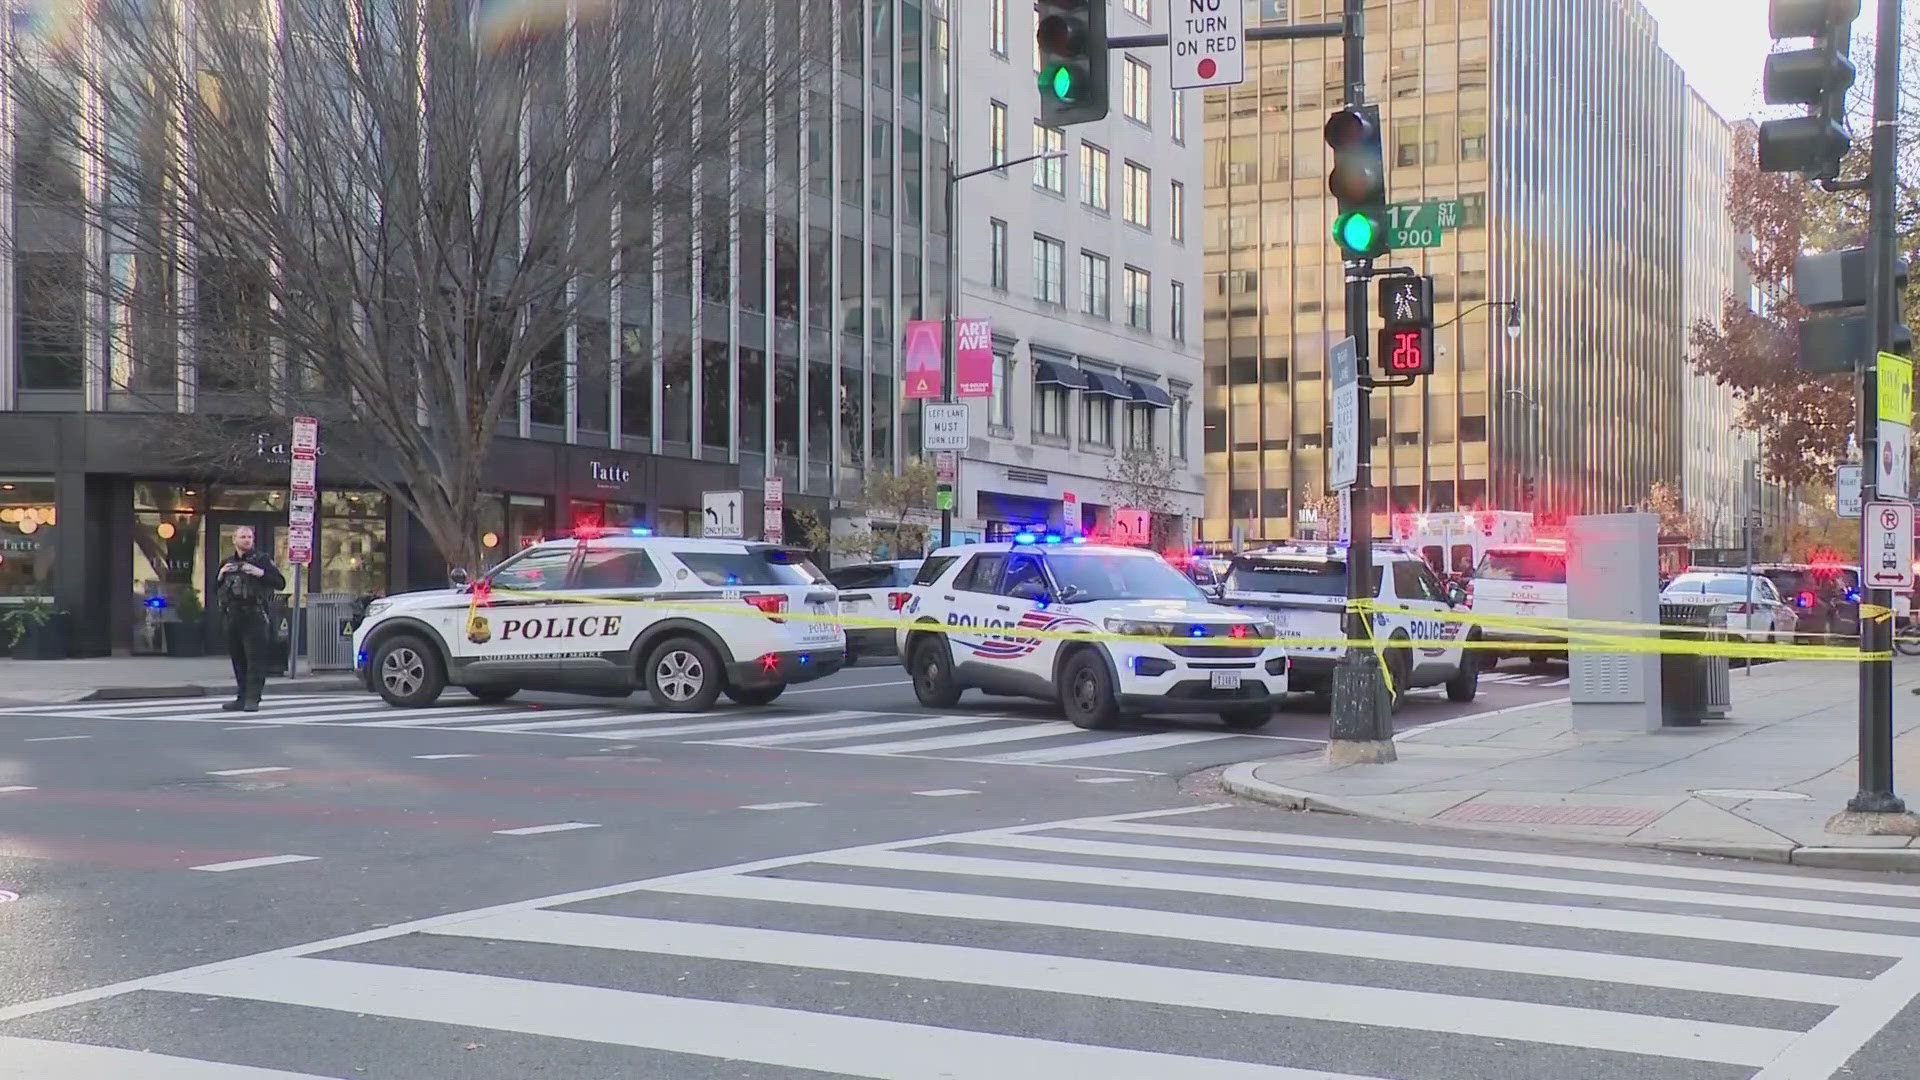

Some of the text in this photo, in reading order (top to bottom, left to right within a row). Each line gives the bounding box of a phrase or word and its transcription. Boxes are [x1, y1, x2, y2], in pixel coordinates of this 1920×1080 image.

[1191, 0, 1220, 13] NO
[1185, 16, 1227, 34] TURN
[1177, 36, 1237, 56] ON RED
[1386, 203, 1455, 228] 17 ST
[1437, 214, 1456, 226] NW
[1398, 230, 1432, 246] 900
[959, 321, 988, 336] ART
[959, 336, 988, 350] AVE
[1393, 333, 1420, 368] 26
[934, 422, 957, 431] MUST
[590, 461, 629, 482] Tatte
[705, 527, 740, 535] ONLY ONLY
[499, 615, 622, 640] POLICE
[1410, 620, 1446, 640] POLICE
